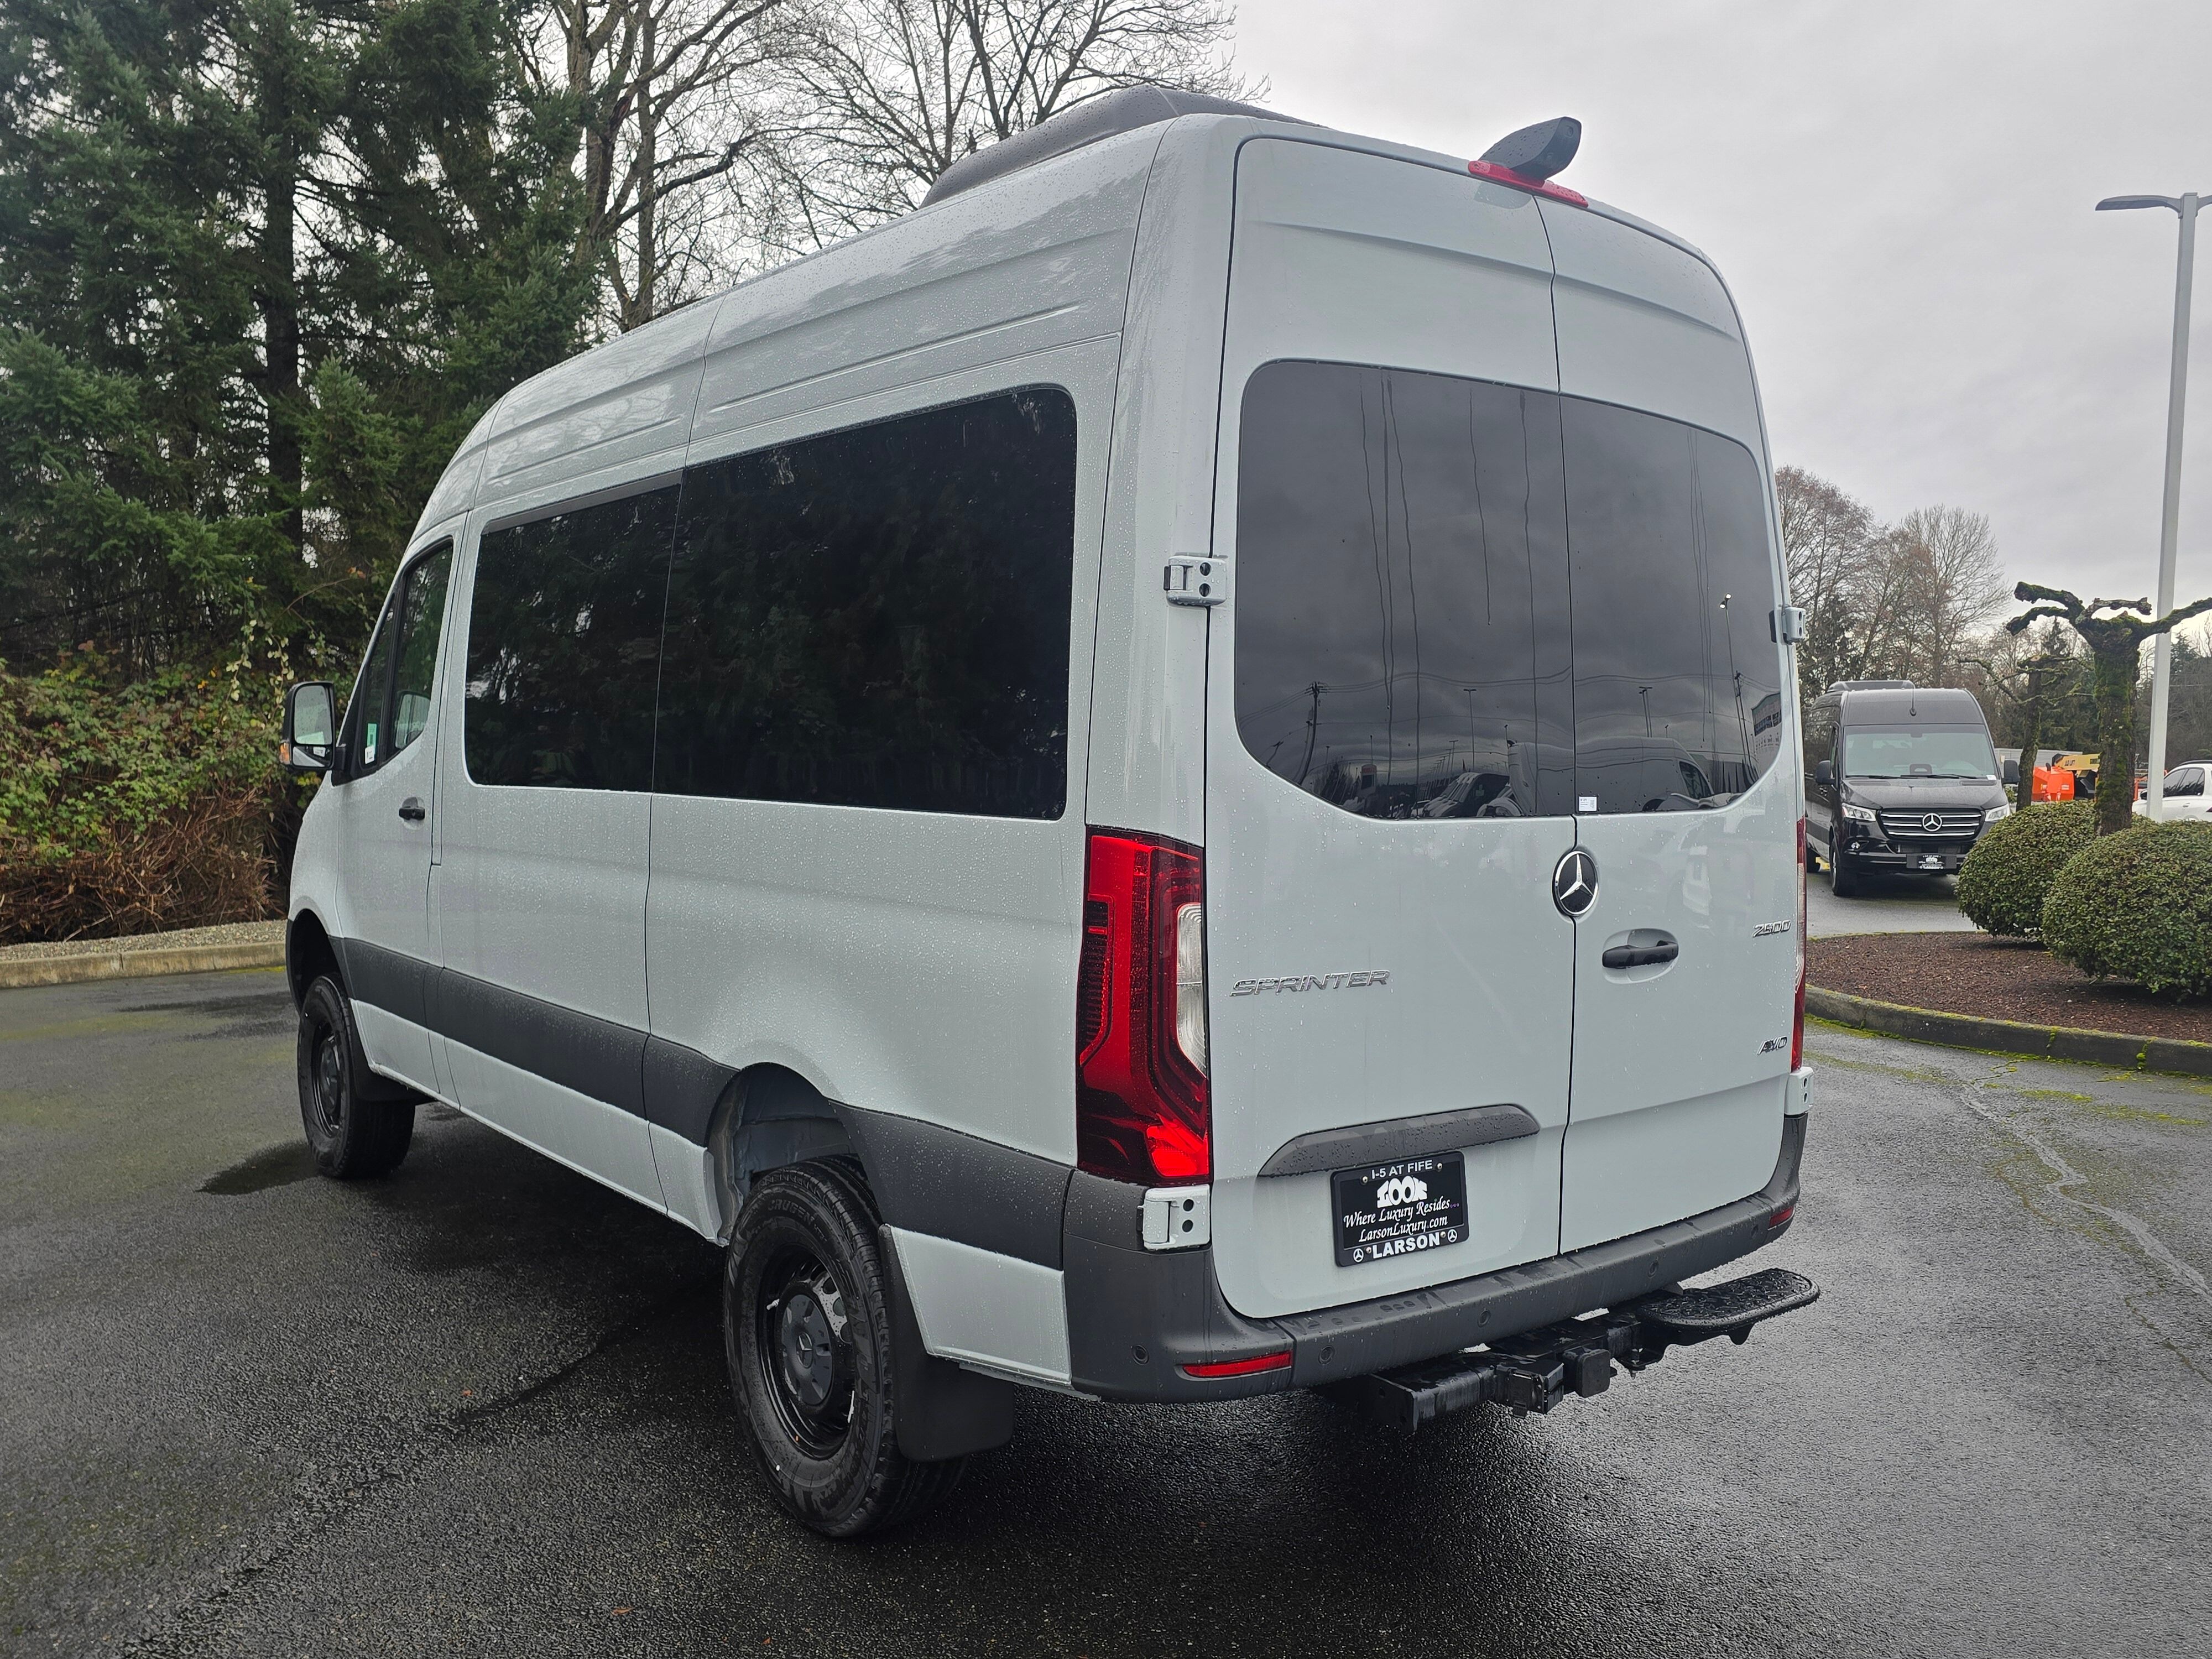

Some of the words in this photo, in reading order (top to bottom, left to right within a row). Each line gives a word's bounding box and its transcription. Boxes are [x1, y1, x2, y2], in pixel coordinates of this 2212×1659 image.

[1752, 919, 1791, 937] 2500
[1229, 969, 1390, 997] SPRINTER
[1371, 1168, 1386, 1180] I-5
[1389, 1165, 1405, 1176] AT
[1407, 1160, 1433, 1173] FIFE
[1343, 1211, 1376, 1228] Where
[1379, 1206, 1413, 1222] Luxury
[1358, 1216, 1448, 1243] LarsonLuxury.com
[1372, 1232, 1440, 1259] LARSON
